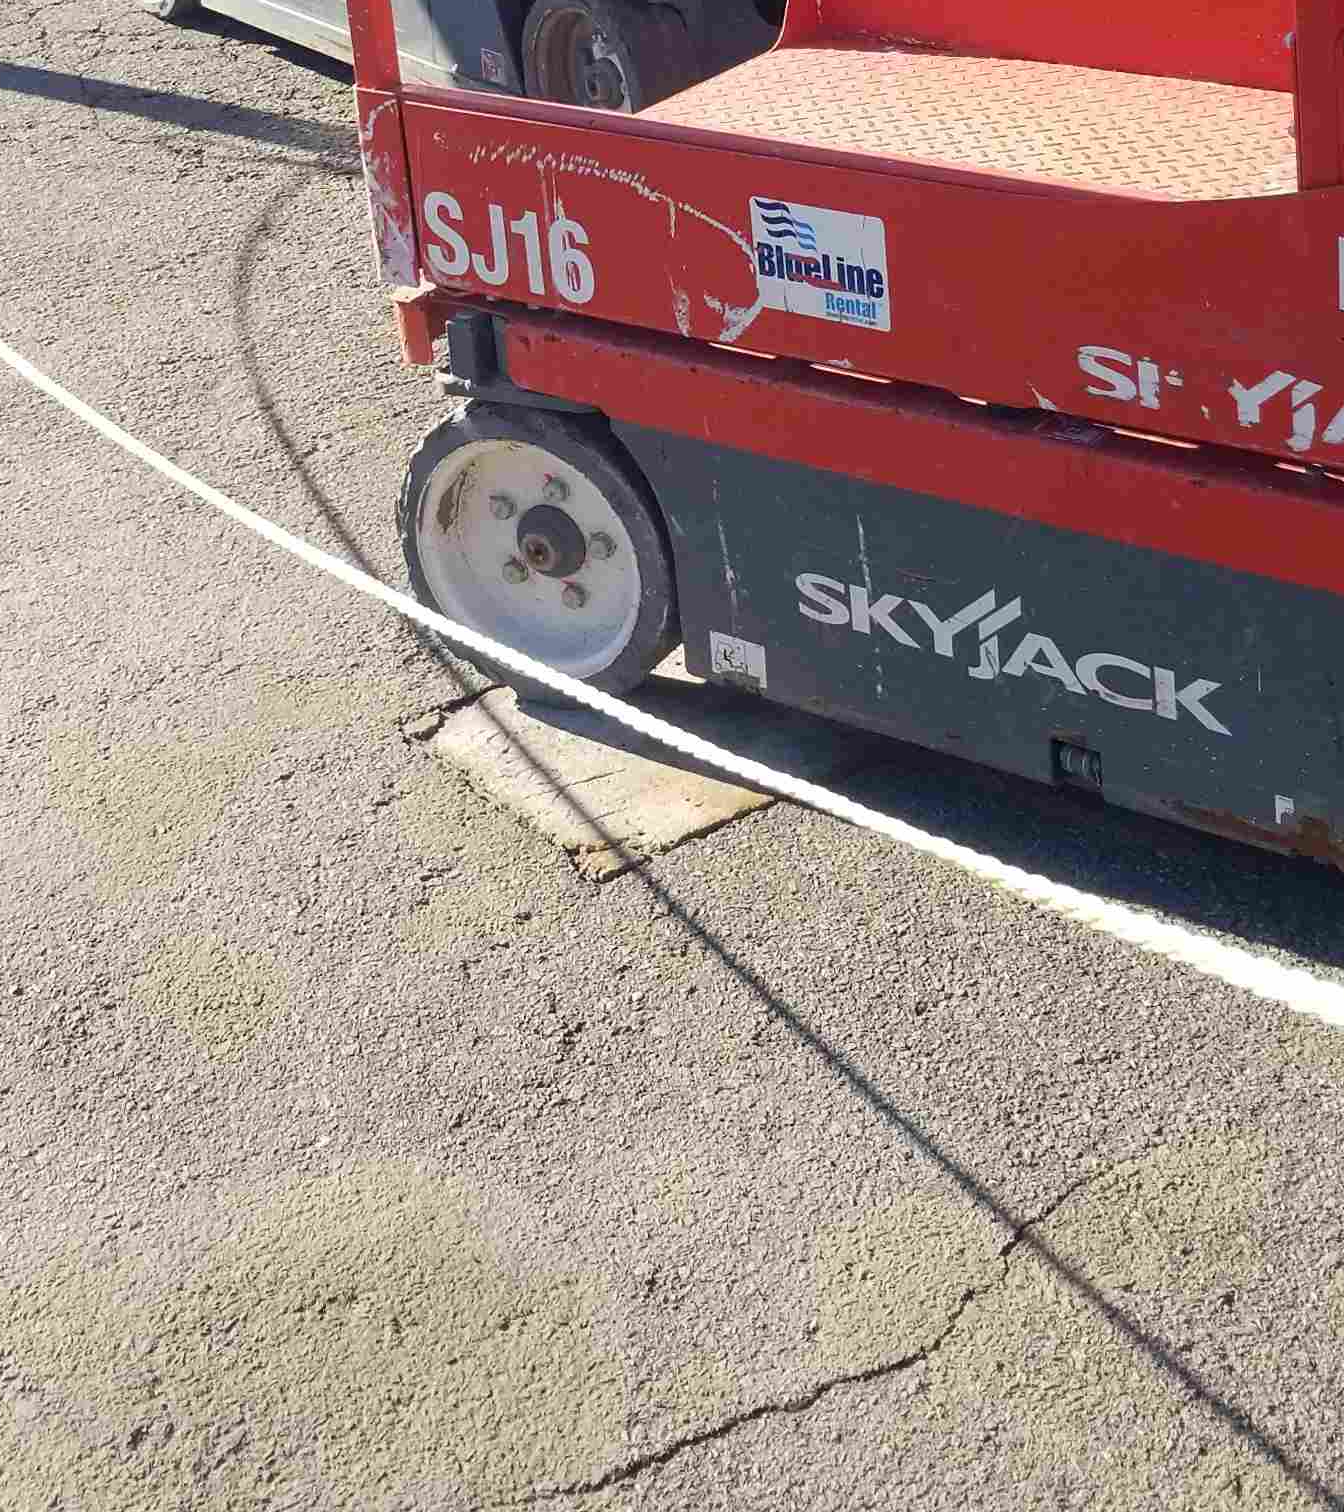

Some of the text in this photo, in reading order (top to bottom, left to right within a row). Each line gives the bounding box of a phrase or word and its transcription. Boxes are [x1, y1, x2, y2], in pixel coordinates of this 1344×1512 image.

[422, 191, 596, 306] SJ16
[756, 241, 885, 299] BlueLine
[824, 291, 878, 320] Rental
[795, 571, 1234, 737] SKYJACK
